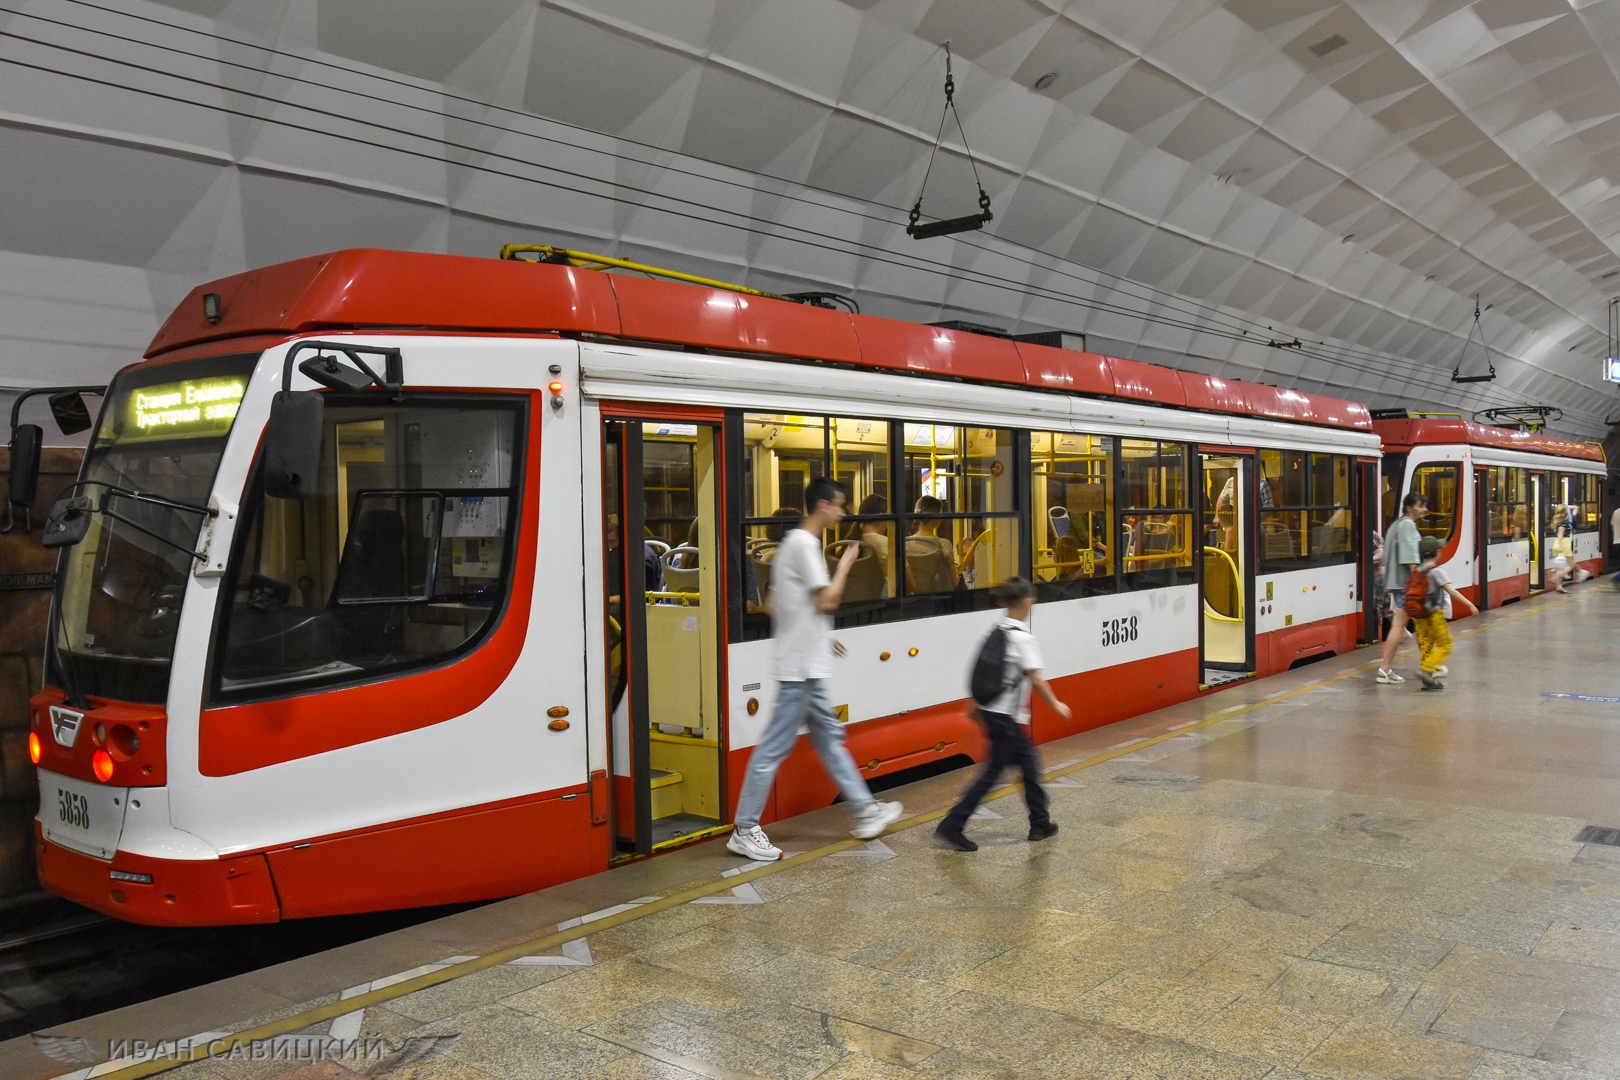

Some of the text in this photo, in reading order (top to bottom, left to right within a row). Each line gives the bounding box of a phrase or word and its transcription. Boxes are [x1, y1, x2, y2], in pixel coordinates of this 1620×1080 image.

[137, 384, 243, 410] Станция Ельшанка
[137, 403, 240, 428] Тракторный заво
[1101, 615, 1138, 647] 5858
[58, 788, 89, 830] 5858
